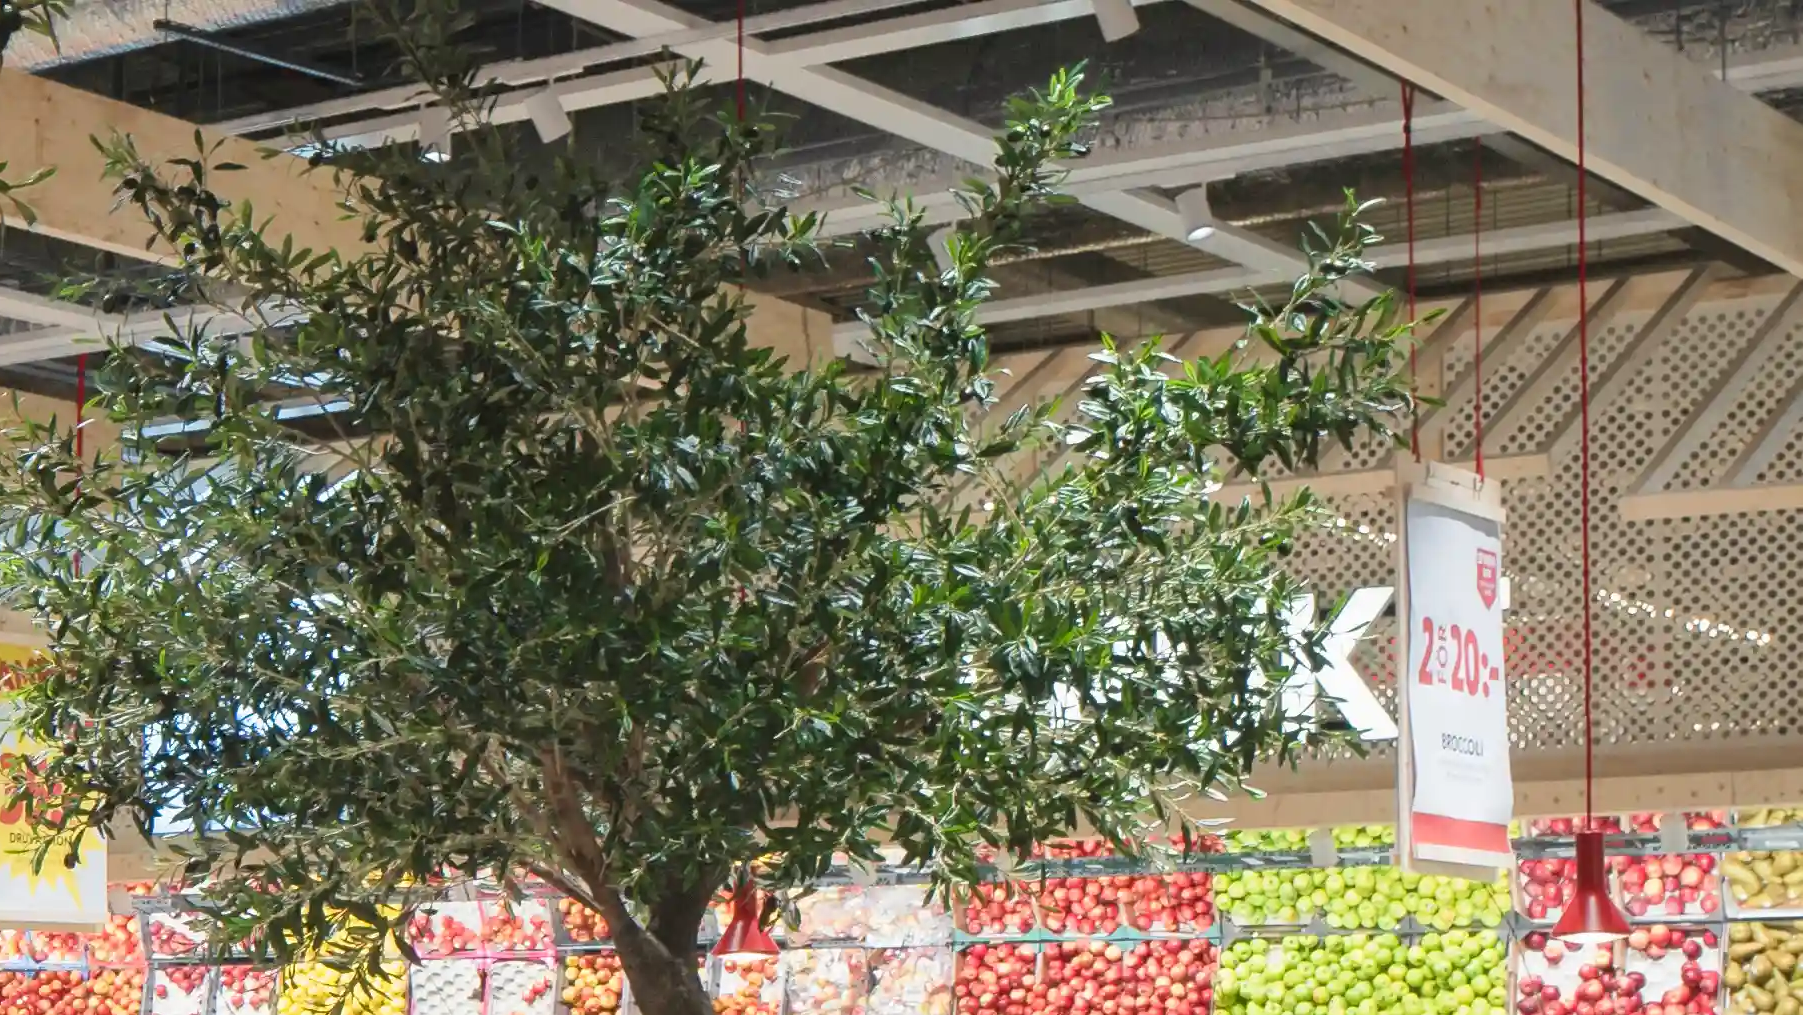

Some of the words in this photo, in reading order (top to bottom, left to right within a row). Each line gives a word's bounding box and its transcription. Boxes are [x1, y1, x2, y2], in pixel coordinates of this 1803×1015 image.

[1418, 616, 1434, 685] 2
[1437, 625, 1447, 684] FOR
[1441, 733, 1484, 757] BROCCOLI
